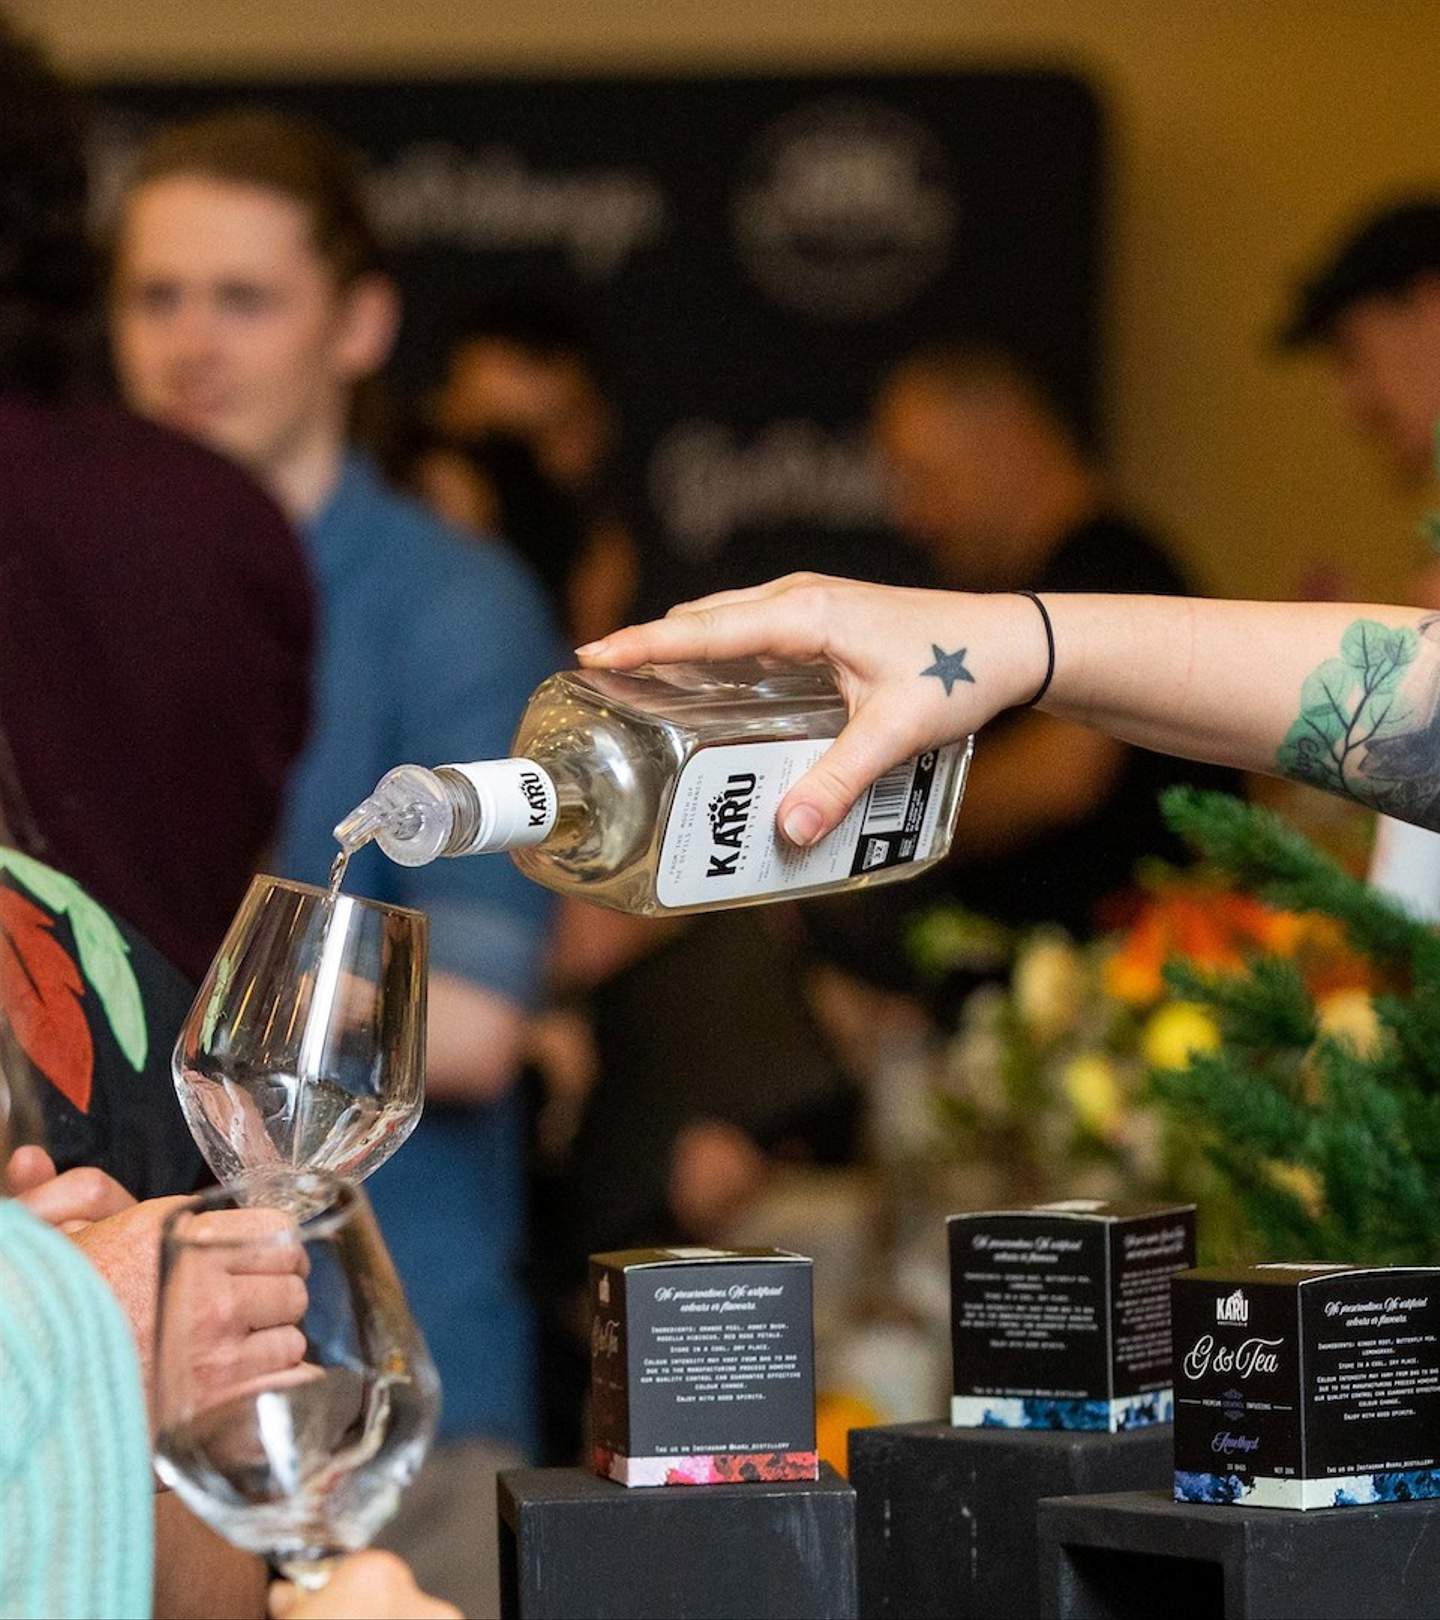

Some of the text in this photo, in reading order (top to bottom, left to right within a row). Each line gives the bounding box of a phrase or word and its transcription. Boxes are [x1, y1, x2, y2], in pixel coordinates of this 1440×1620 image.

[520, 773, 547, 827] KARU
[706, 773, 757, 878] KARU
[1216, 1290, 1249, 1322] KARU
[1183, 1334, 1284, 1380] G & Tea
